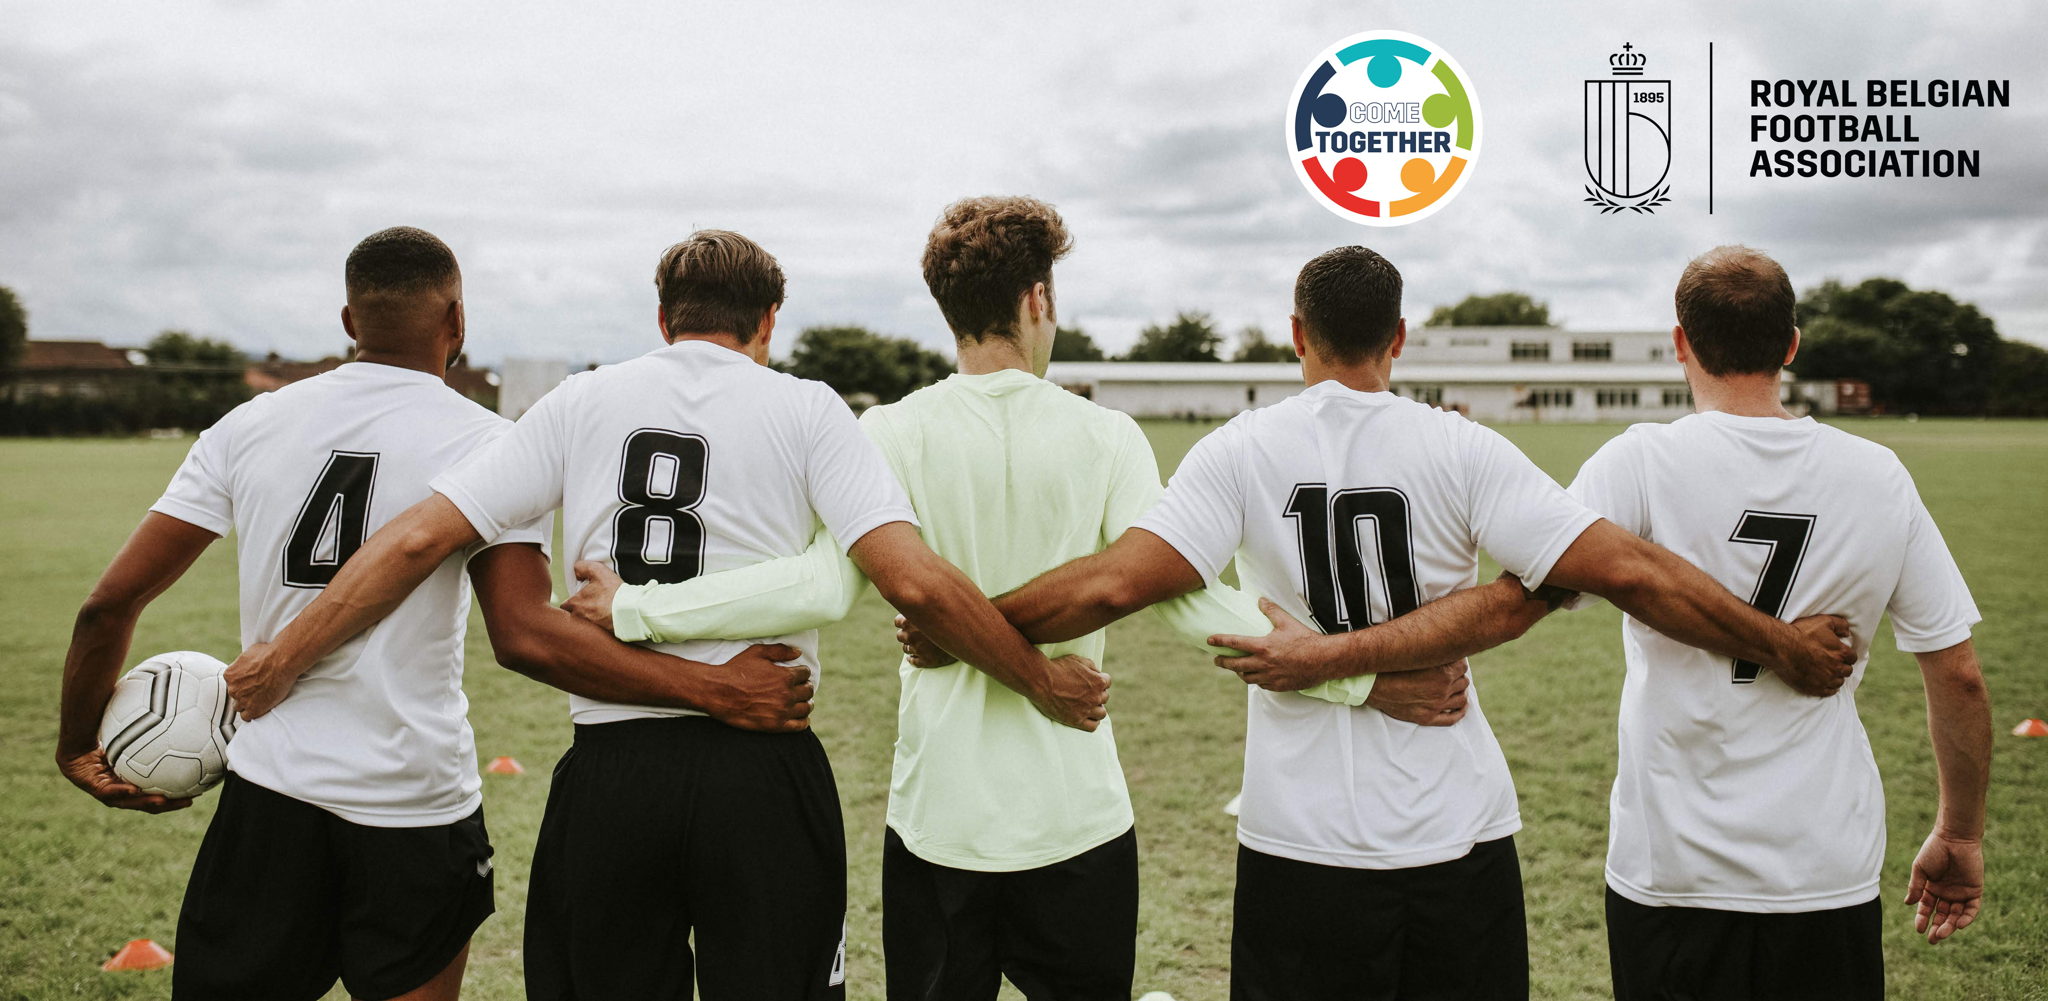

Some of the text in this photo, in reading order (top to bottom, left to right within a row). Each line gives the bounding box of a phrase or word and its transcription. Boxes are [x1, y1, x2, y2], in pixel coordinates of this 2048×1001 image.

[282, 450, 380, 589] 4
[610, 427, 710, 585] 8
[1282, 483, 1422, 635] 10
[1728, 510, 1817, 684] 7
